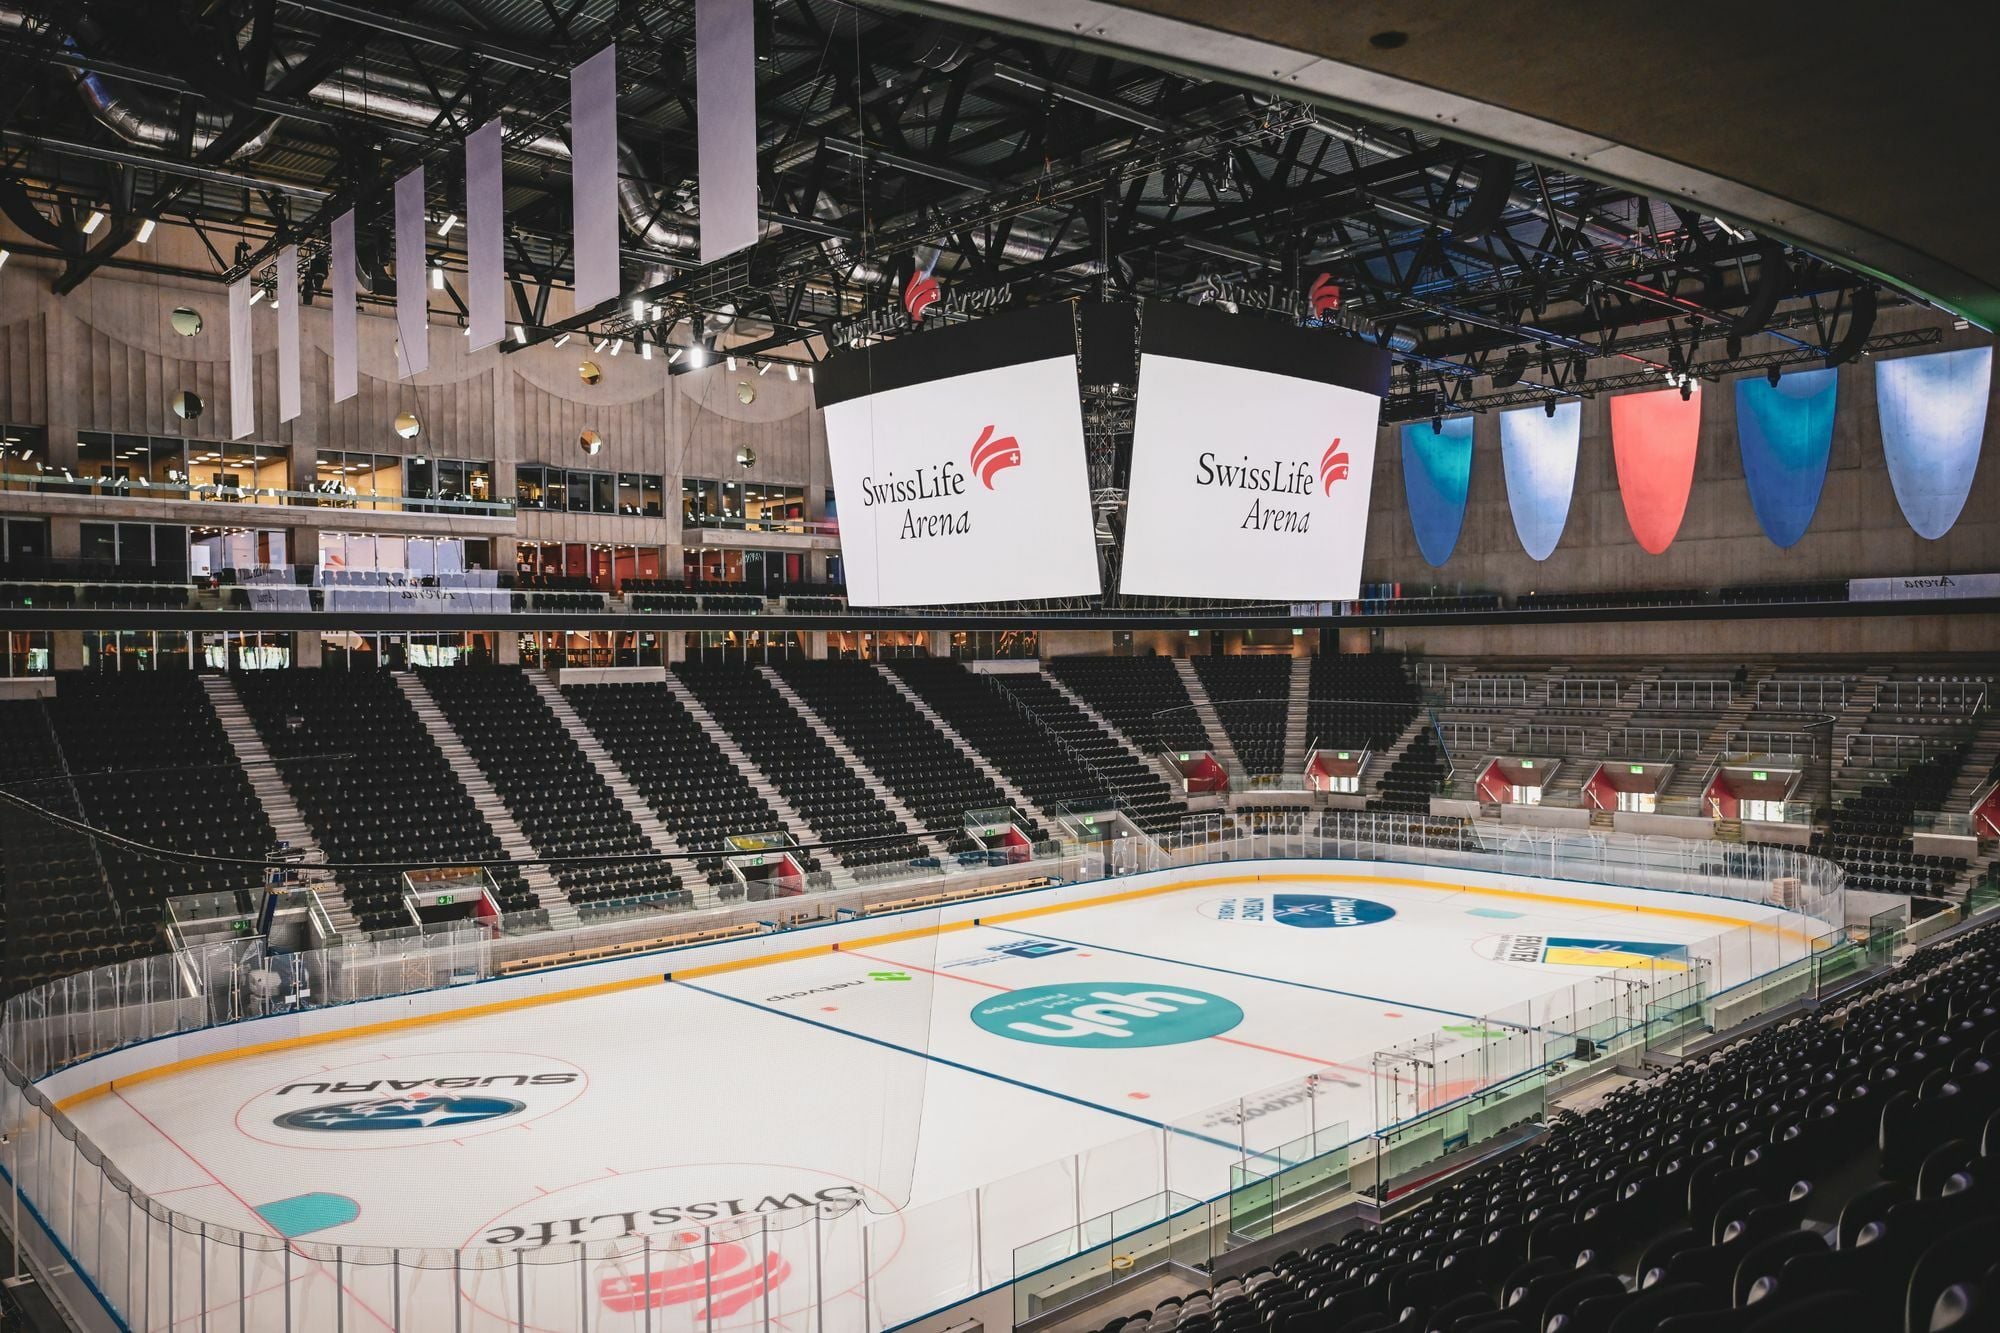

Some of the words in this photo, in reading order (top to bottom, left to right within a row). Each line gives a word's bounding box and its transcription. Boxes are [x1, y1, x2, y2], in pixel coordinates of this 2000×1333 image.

[863, 461, 965, 507] SwissLife
[1196, 453, 1314, 497] SwissLife
[900, 508, 971, 539] Arena
[1242, 499, 1310, 534] Arena
[1508, 934, 1543, 963] FENSTER
[1007, 991, 1207, 1038] yuh
[275, 1073, 578, 1096] SUBARU
